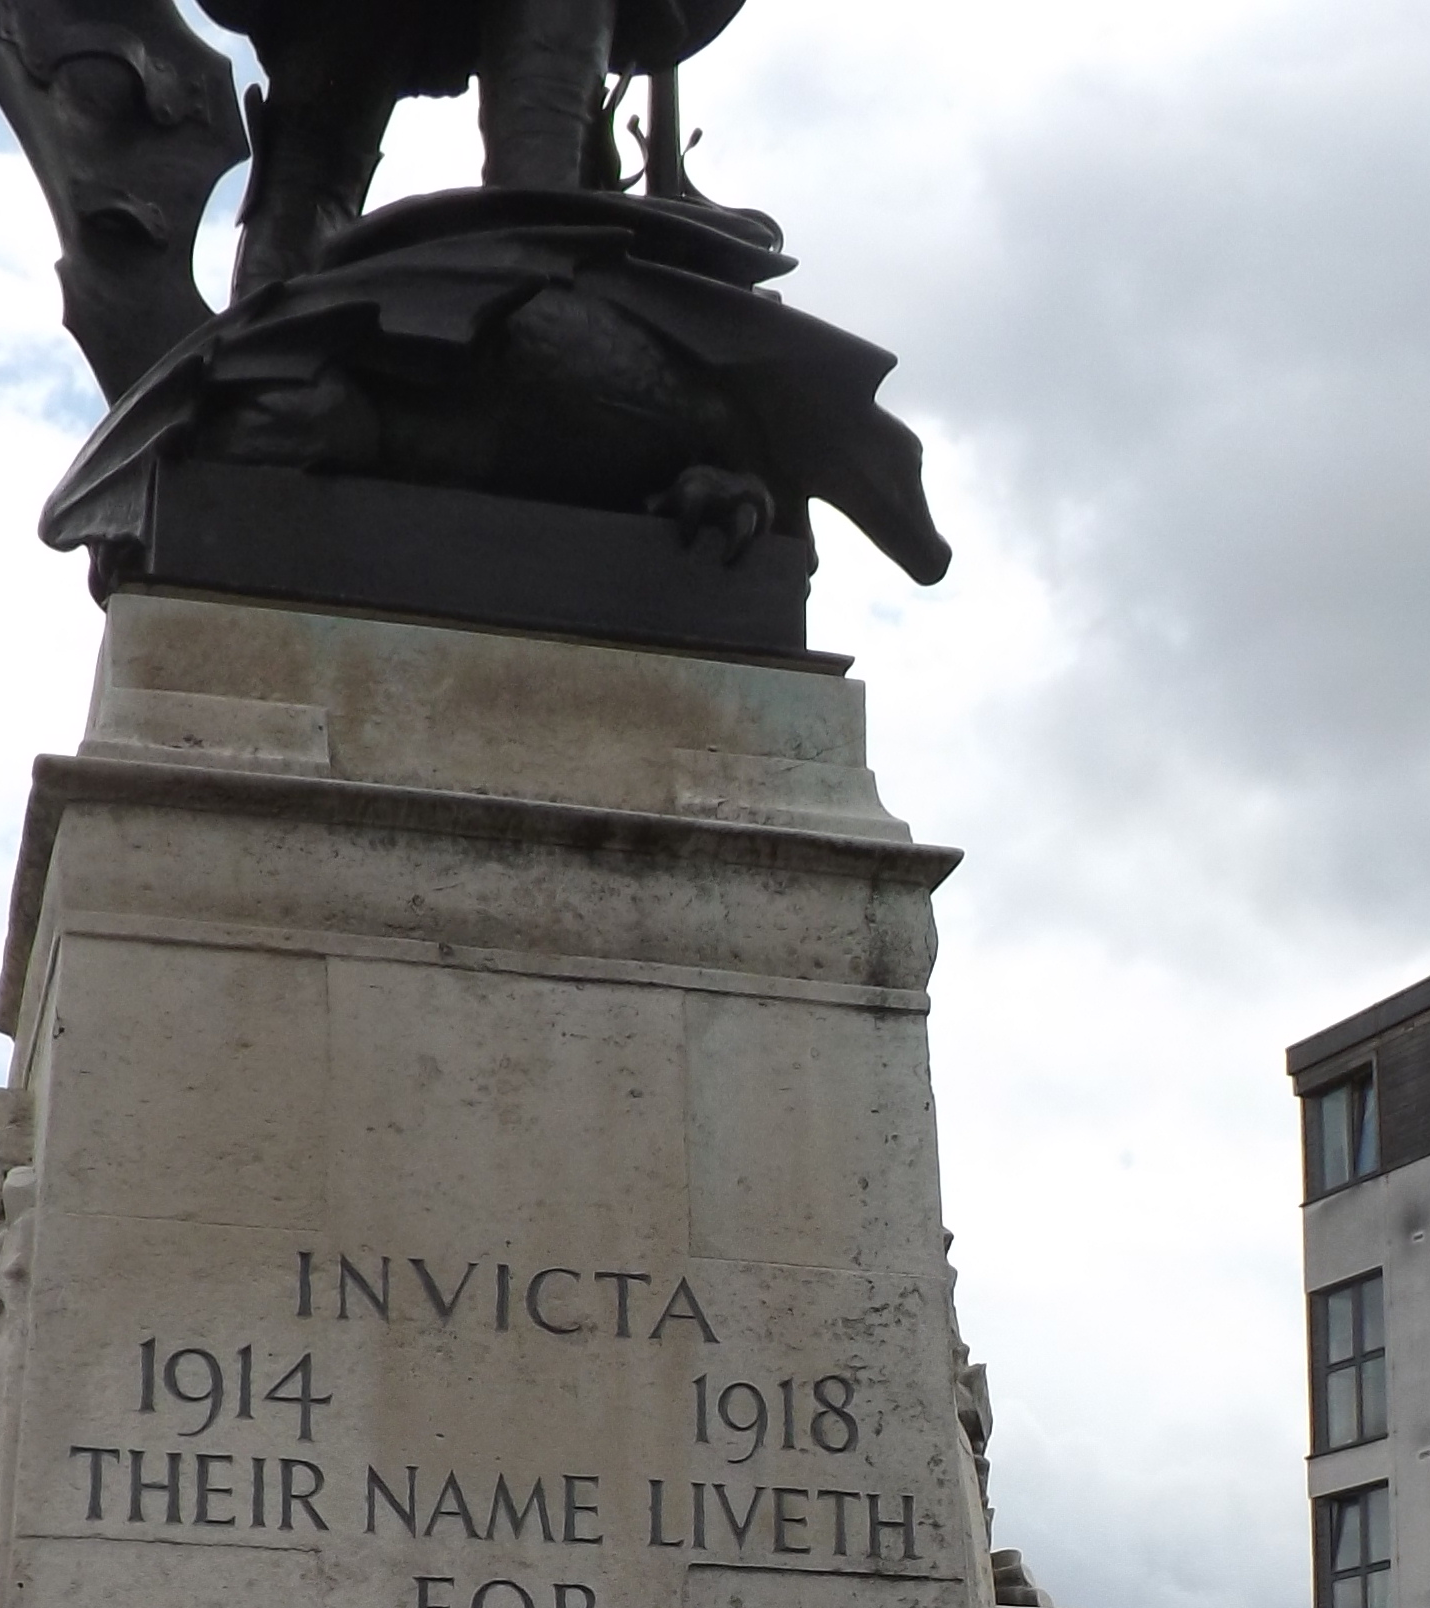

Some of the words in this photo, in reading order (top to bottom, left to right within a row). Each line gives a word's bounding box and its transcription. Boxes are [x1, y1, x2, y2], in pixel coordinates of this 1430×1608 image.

[296, 1250, 720, 1345] INVICTA
[138, 1336, 333, 1443] 1914
[692, 1373, 860, 1464] 1918
[69, 1445, 330, 1533] THEIR
[366, 1464, 605, 1546] NAME
[647, 1478, 923, 1561] LIVETH
